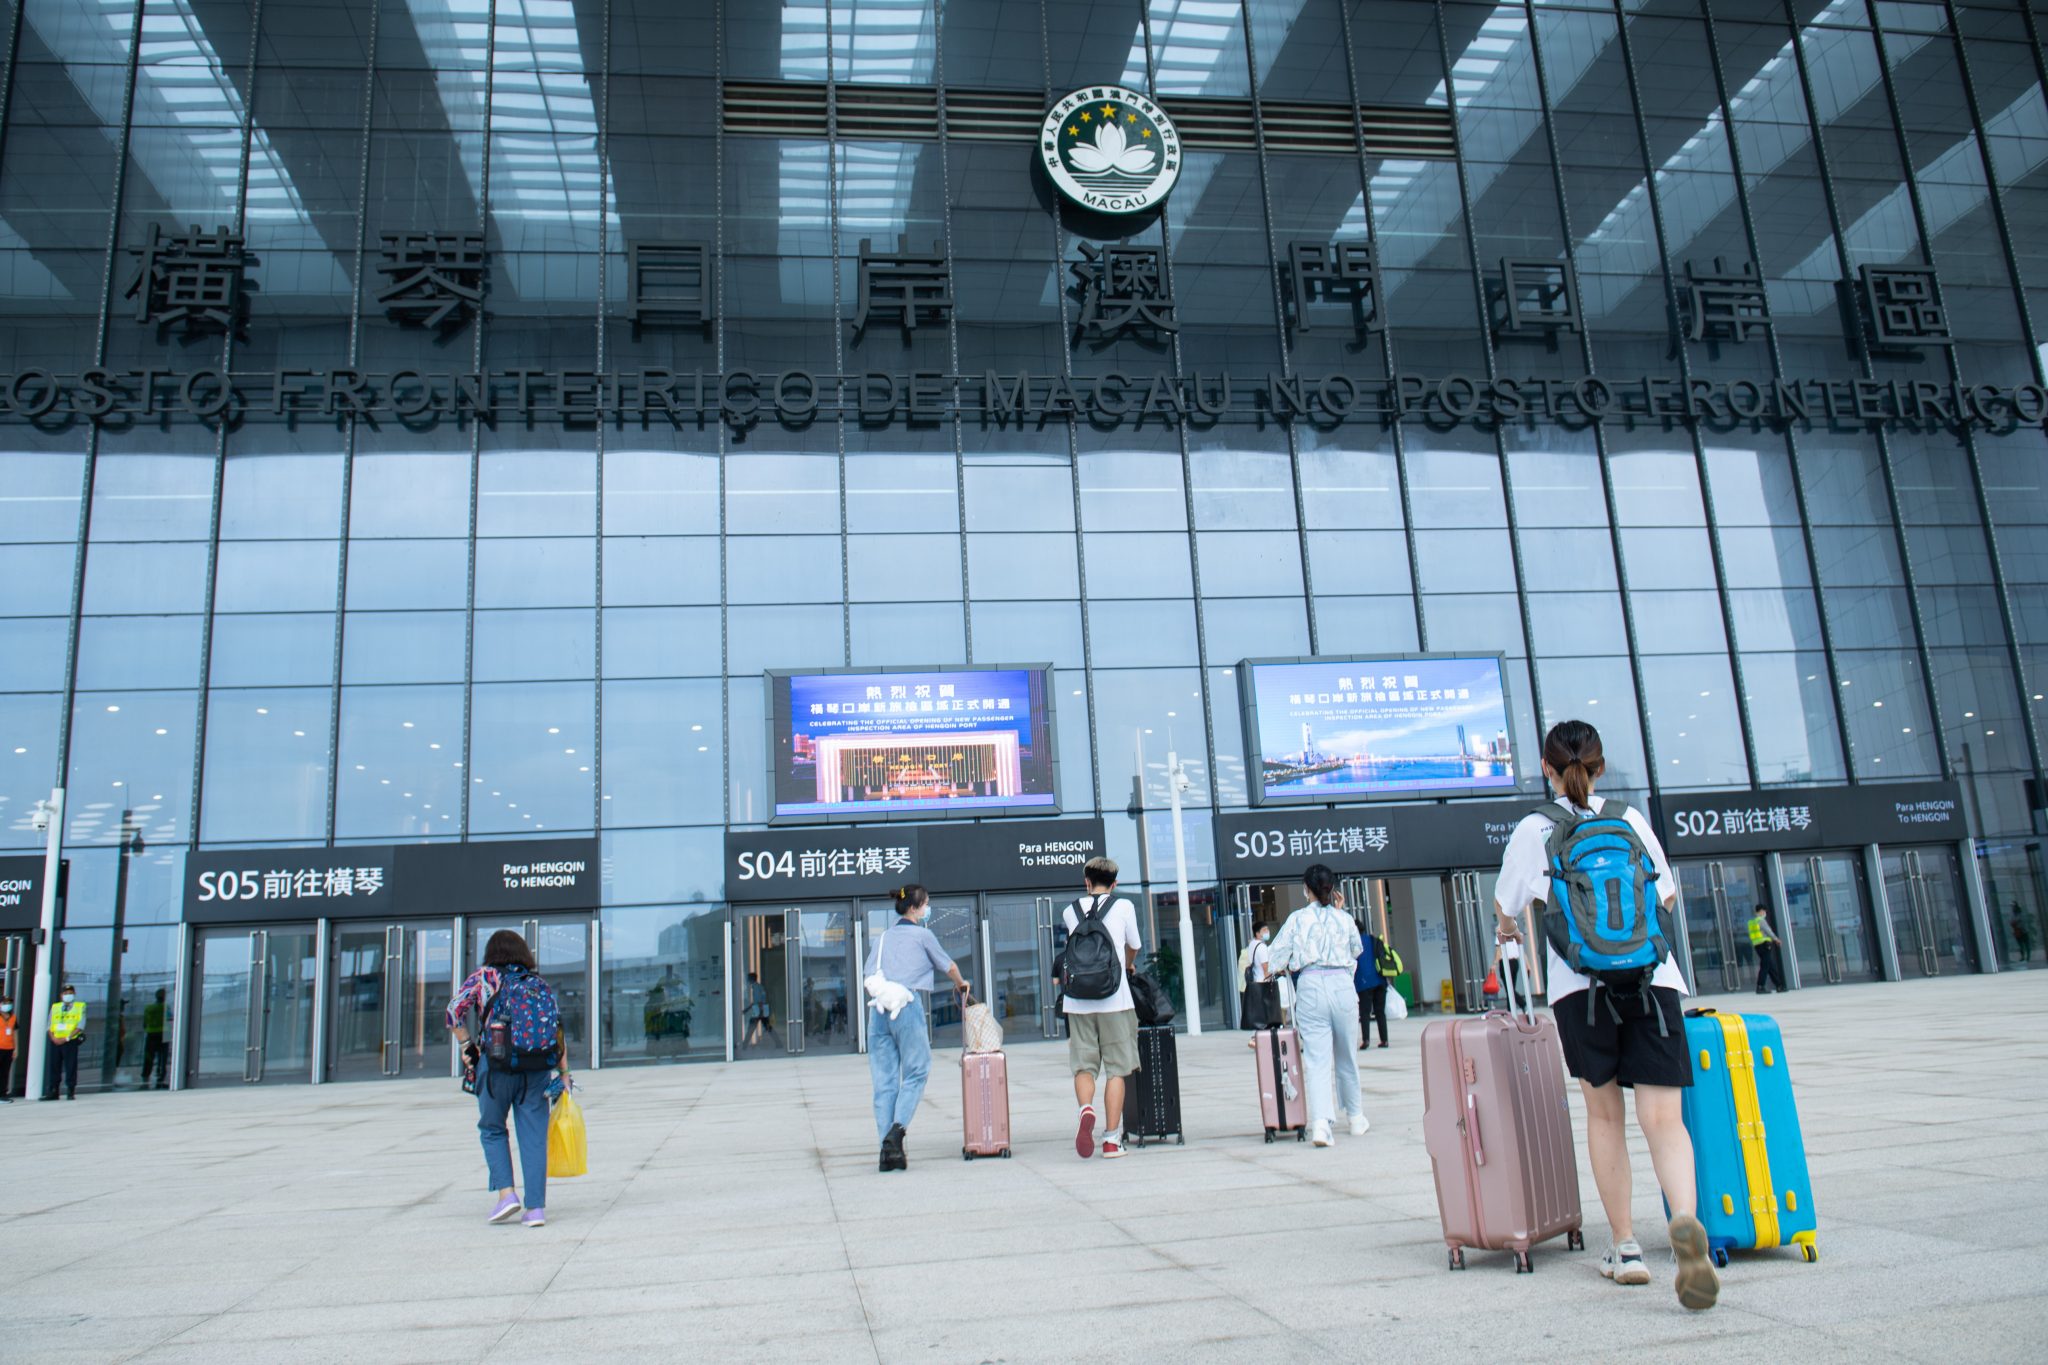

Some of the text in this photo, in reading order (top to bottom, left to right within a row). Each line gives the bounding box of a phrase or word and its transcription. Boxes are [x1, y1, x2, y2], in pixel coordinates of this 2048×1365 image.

[1083, 192, 1148, 211] MACAU
[6, 366, 2047, 432] OSTO FRONTEIRIÇO DE MACAU NO POSTO FRONTEIRIÇO
[1896, 800, 1955, 812] Para HENGQIN
[1674, 805, 1812, 838] S02 前往橫琴
[1898, 812, 1950, 823] To HENGQIN
[1485, 822, 1506, 833] Para
[1234, 826, 1389, 859] S03 前往橫琴
[1486, 834, 1500, 844] To
[1019, 840, 1094, 853] Para HENGQIN
[738, 846, 911, 881] S04 前往橫琴
[1020, 854, 1086, 866] To HENGQIN
[503, 861, 585, 875] Para HENGQIN
[0, 879, 32, 892] GQIN
[198, 867, 384, 901] S05 前往橫琴
[503, 875, 575, 888] To HENGQIN
[0, 894, 20, 907] QIN
